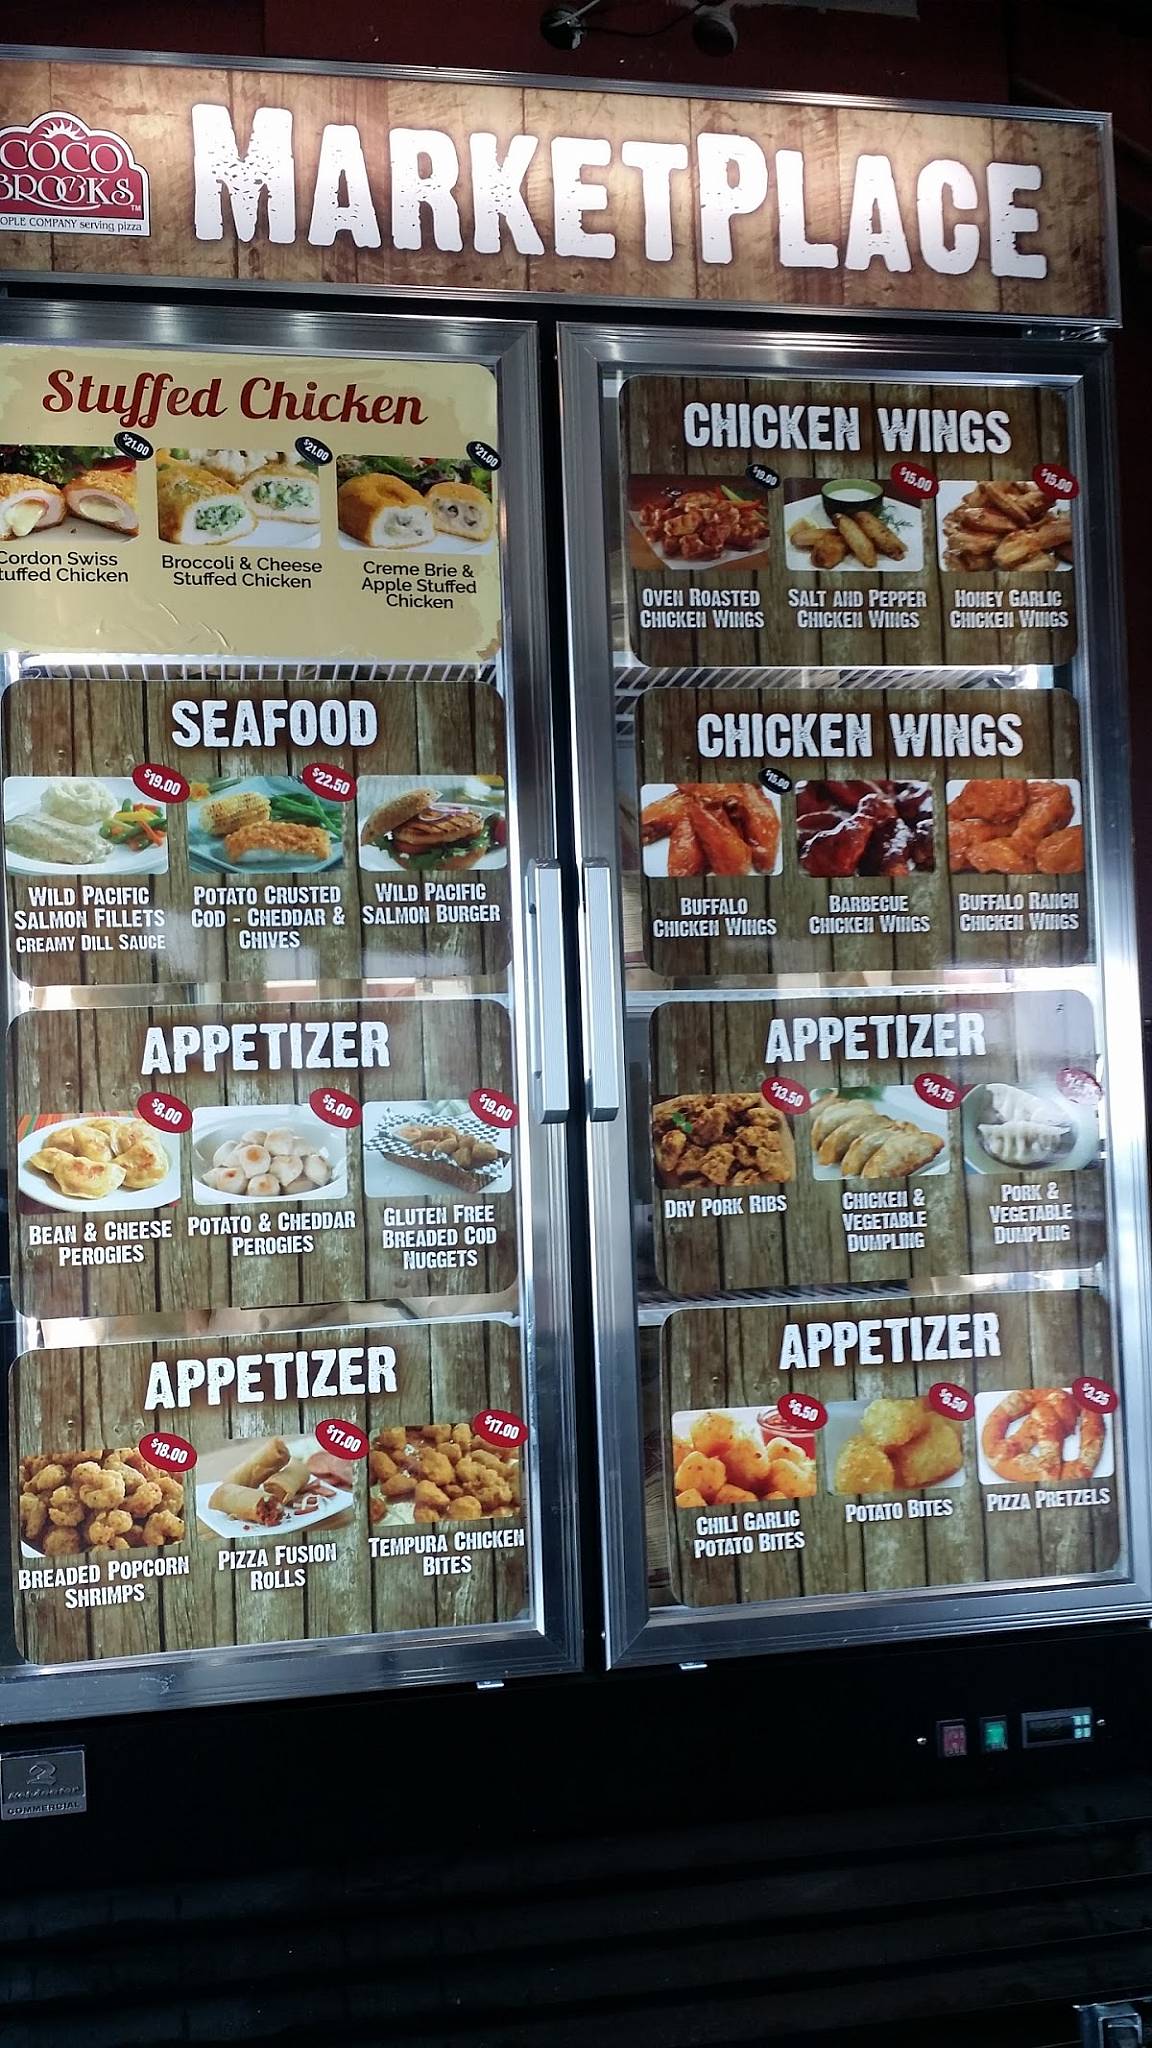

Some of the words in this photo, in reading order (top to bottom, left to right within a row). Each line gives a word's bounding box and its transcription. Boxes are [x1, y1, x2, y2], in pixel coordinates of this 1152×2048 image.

[0, 140, 123, 173] COCO
[191, 104, 1047, 279] MARKETPLACE
[0, 217, 26, 226] OPLE
[29, 218, 77, 228] COMPANY
[80, 220, 115, 232] serving
[117, 221, 142, 232] pizza
[43, 369, 228, 428] Stuffed
[240, 376, 428, 425] Chicken
[683, 402, 861, 451] CHICKEN
[877, 407, 1012, 454] WINGS
[123, 433, 149, 456] $21.00
[303, 438, 329, 462] $21.00
[475, 443, 498, 468] $21.00
[900, 466, 932, 492] $15.00
[1041, 468, 1073, 492] $15.00
[0, 550, 62, 566] Cordon
[67, 551, 118, 566] Swiss
[162, 554, 234, 570] Broccoli
[240, 557, 251, 570] &
[257, 558, 322, 572] Cheese
[363, 560, 420, 576] Creme
[425, 563, 457, 577] Brie
[462, 564, 474, 578] &
[0, 567, 51, 582] tuffed
[62, 568, 129, 582] Chicken
[173, 571, 236, 586] Stuffed
[242, 573, 312, 588] Chicken
[361, 577, 412, 594] Apple
[417, 579, 476, 594] Stuffed
[386, 594, 454, 609] Chicken
[642, 588, 684, 607] OVEN
[689, 588, 760, 607] ROASTED
[788, 588, 827, 607] SALT
[869, 589, 926, 608] PEPPER
[954, 589, 1003, 608] HONEY
[1008, 589, 1062, 608] GARLIC
[640, 610, 707, 628] CHICKEN
[712, 610, 765, 628] WINGS
[797, 610, 863, 628] CHICKEN
[868, 610, 920, 628] WINGS
[950, 610, 1014, 628] CHICKEN
[1019, 610, 1069, 628] WINGS
[171, 699, 378, 748] SEAFOOD
[697, 712, 873, 758] CHICKEN
[889, 713, 1024, 758] WINGS
[144, 768, 181, 796] $19.00
[312, 767, 350, 796] $22.50
[28, 886, 76, 906] WILD
[82, 885, 150, 906] PACIFIC
[193, 886, 258, 905] POTATO
[264, 885, 341, 904] CRUSTED
[375, 883, 418, 903] WILD
[424, 882, 486, 902] PACIFIC
[829, 894, 908, 913] BARBECUE
[959, 893, 1023, 911] BUFFALO
[1028, 892, 1079, 910] RANCH
[191, 908, 226, 928] COD
[248, 907, 326, 927] CHEDDAR
[332, 908, 345, 926] &
[362, 904, 430, 925] SALMON
[436, 904, 501, 922] BURGER
[680, 898, 748, 916] BUFFALO
[14, 909, 87, 930] SALMON
[94, 908, 166, 928] FILLETS
[653, 918, 720, 938] CHICKEN
[724, 918, 777, 936] WINGS
[808, 916, 874, 934] CHICKEN
[880, 914, 931, 933] WINGS
[960, 913, 1024, 932] CHICKEN
[1028, 912, 1080, 930] WINGS
[16, 935, 76, 954] CREAMY
[81, 934, 113, 951] DILL
[119, 934, 166, 950] SAUCE
[240, 930, 300, 950] CHIVES
[140, 1021, 390, 1075] APPETIZER
[765, 1012, 986, 1064] APPETIZER
[152, 1098, 182, 1125] $8.00
[322, 1094, 352, 1120] $5.00
[478, 1093, 512, 1121] $19.00
[842, 1190, 908, 1210] CHICKEN
[913, 1188, 925, 1206] &
[1001, 1184, 1042, 1202] PORK
[1046, 1182, 1059, 1200] &
[383, 1207, 446, 1227] GLUTEN
[454, 1204, 495, 1223] FREE
[664, 1199, 696, 1219] DRY
[701, 1196, 744, 1217] PORK
[749, 1194, 788, 1214] RIBS
[990, 1203, 1072, 1224] VEGETABLE
[187, 1216, 252, 1236] POTATO
[258, 1213, 271, 1233] &
[278, 1210, 356, 1232] CHEDDAR
[842, 1210, 927, 1232] VEGETABLE
[29, 1224, 76, 1246] BEAN
[83, 1222, 97, 1243] &
[104, 1220, 172, 1241] CHEESE
[382, 1228, 458, 1249] BREADED
[464, 1226, 497, 1245] COD
[848, 1232, 925, 1252] DUMPLING
[994, 1224, 1070, 1245] DUMPLING
[59, 1244, 145, 1266] PEROGIES
[232, 1235, 314, 1256] PEROGIES
[403, 1250, 478, 1270] NUGGETS
[779, 1312, 1000, 1370] APPETIZER
[144, 1346, 397, 1410] APPETIZER
[327, 1424, 362, 1452] $17.00
[484, 1414, 520, 1440] $17.00
[150, 1438, 188, 1464] $18.00
[845, 1502, 902, 1523] POTATO
[908, 1498, 953, 1518] BITES
[986, 1493, 1031, 1512] PIZZA
[1035, 1487, 1111, 1509] PRETZELS
[696, 1514, 738, 1536] CHILI
[743, 1510, 800, 1531] GARLIC
[368, 1534, 448, 1558] TEMPURA
[454, 1528, 524, 1550] CHICKEN
[694, 1535, 753, 1558] POTATO
[758, 1531, 806, 1552] BITES
[218, 1548, 268, 1570] PIZZA
[275, 1542, 337, 1566] FUSION
[423, 1555, 472, 1576] BITES
[18, 1566, 100, 1590] BREADED
[108, 1556, 190, 1581] POPCORN
[250, 1568, 306, 1591] ROLLS
[65, 1584, 145, 1608] SHRIMPS
